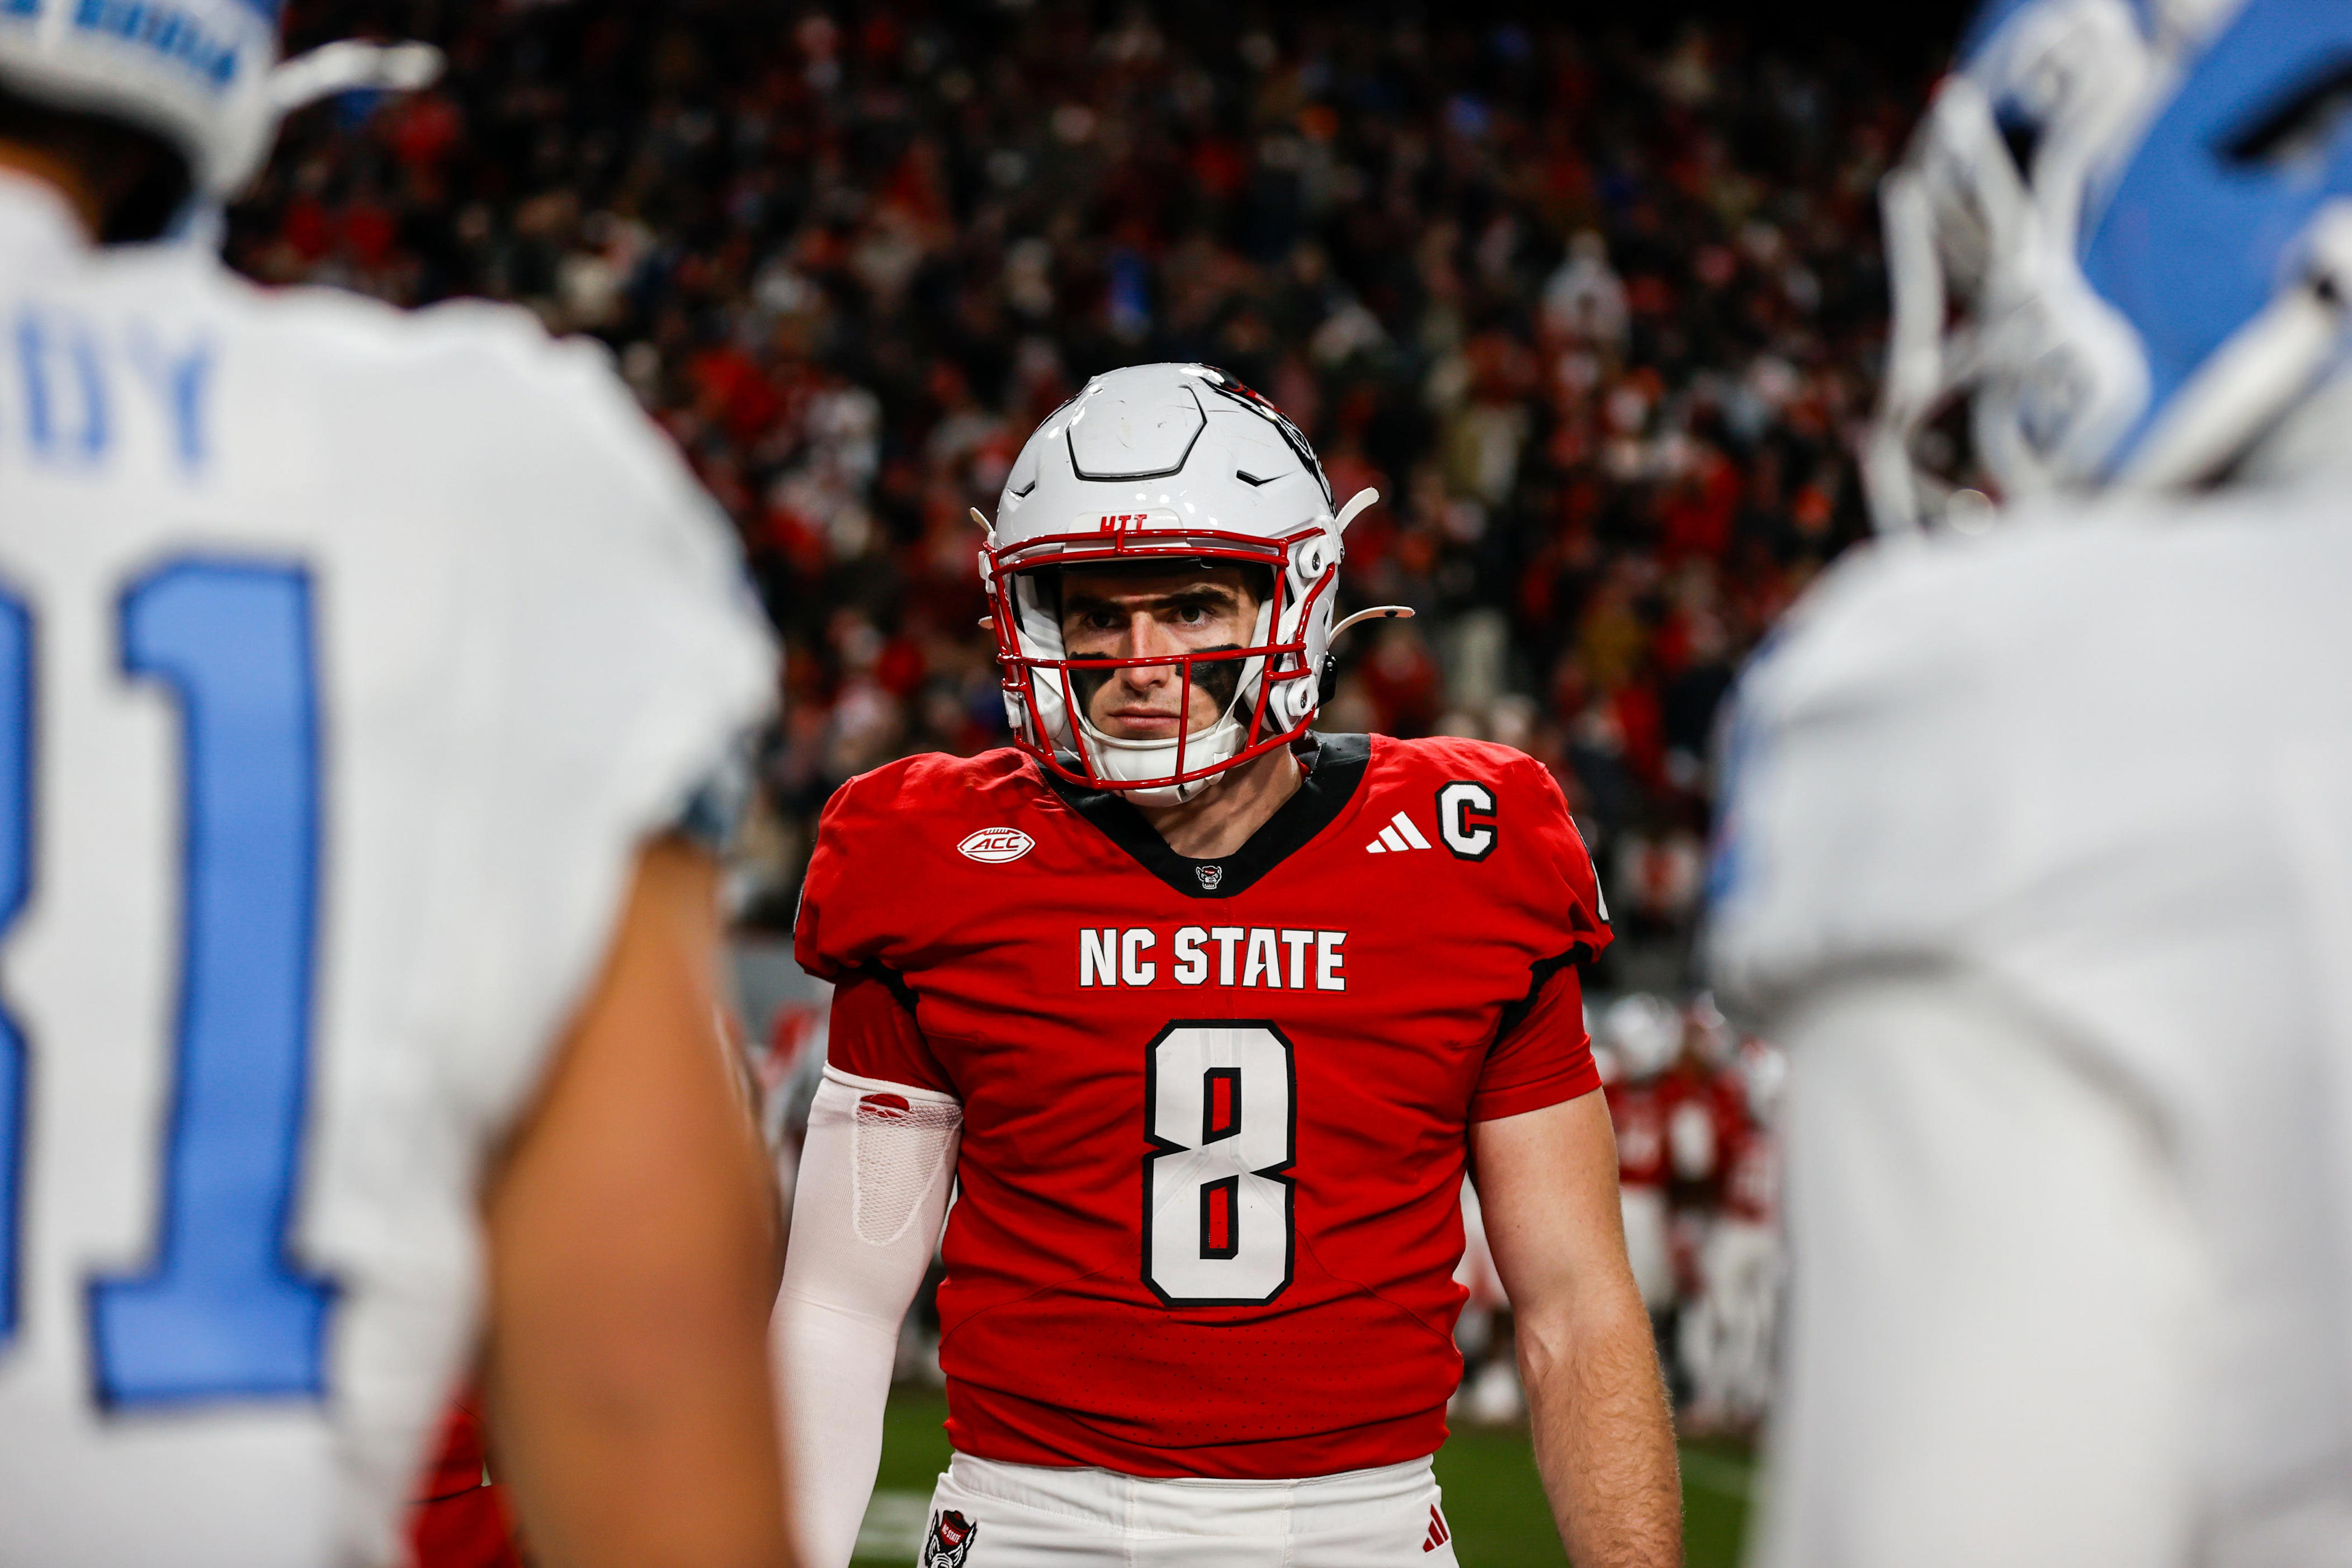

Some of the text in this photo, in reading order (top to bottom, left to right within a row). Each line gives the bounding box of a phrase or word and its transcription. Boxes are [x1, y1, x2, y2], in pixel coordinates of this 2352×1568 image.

[970, 836, 1022, 849] ACC
[1435, 780, 1498, 862] C
[0, 545, 338, 1412] 1
[1079, 926, 1347, 991] NC STATE
[1141, 1019, 1297, 1307] 8
[942, 1524, 961, 1543] NC STATE
